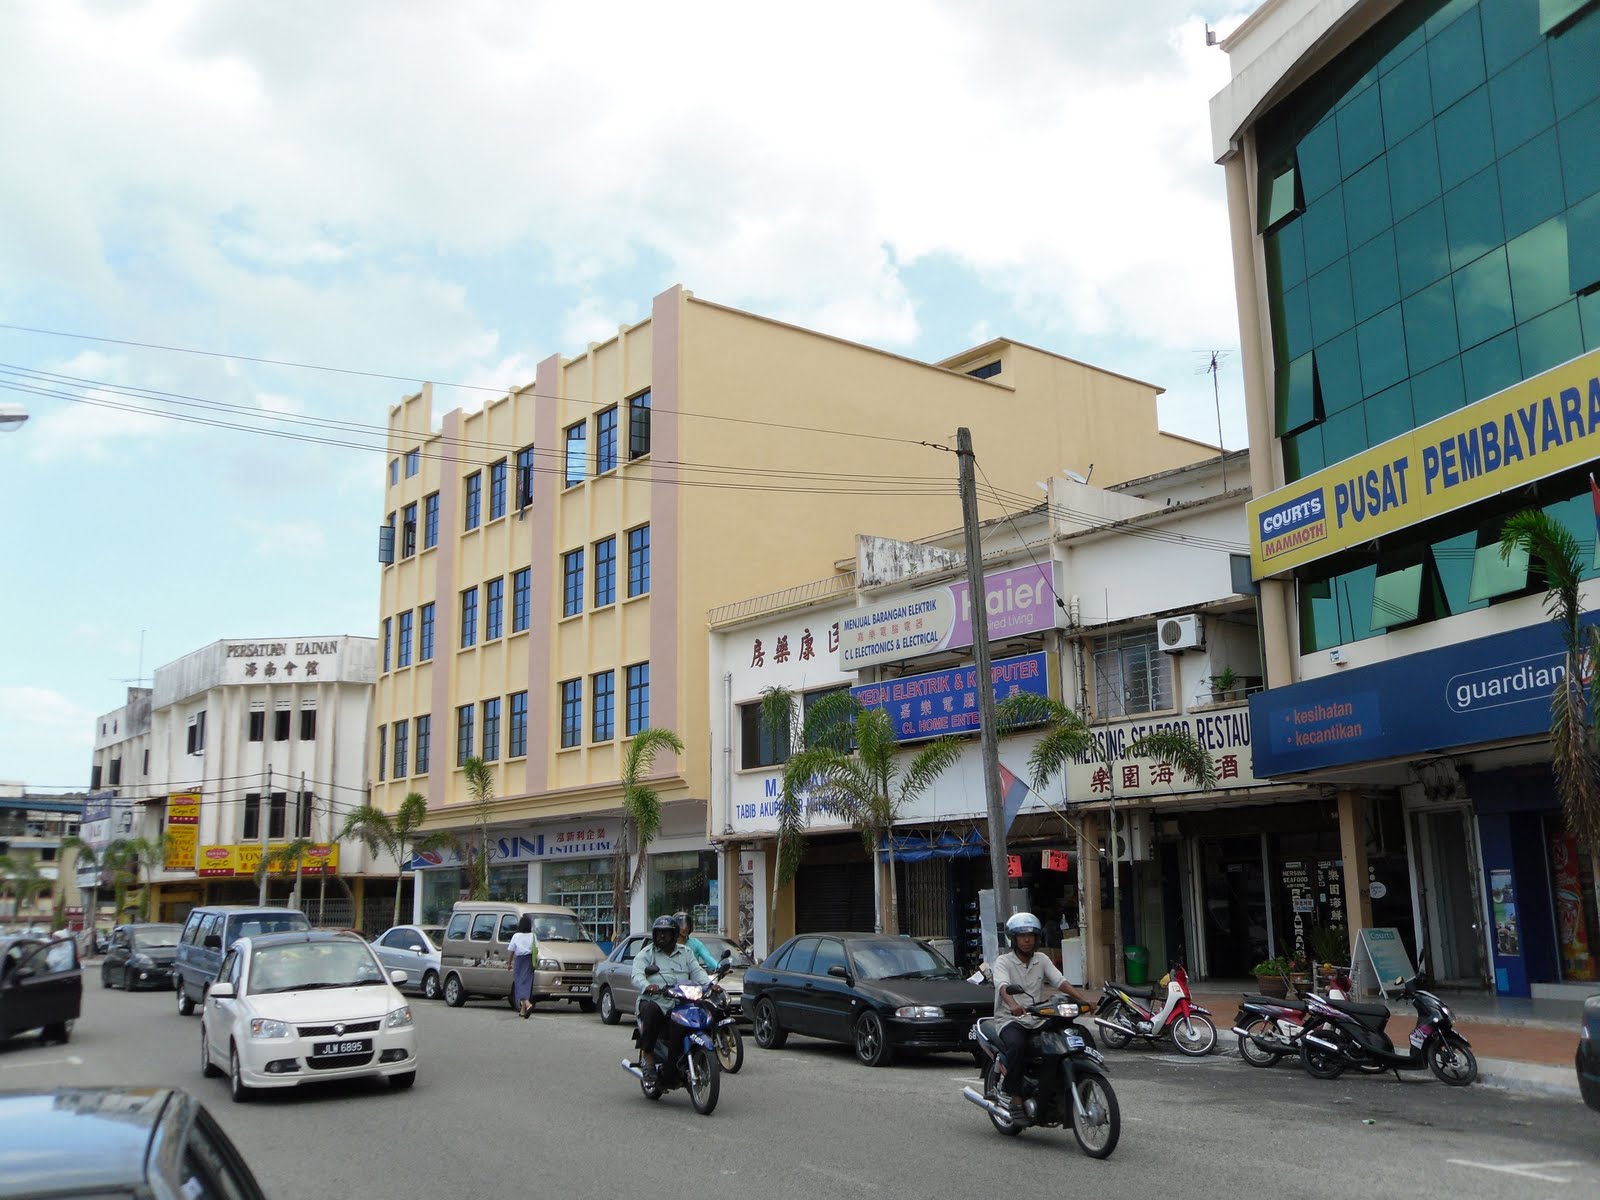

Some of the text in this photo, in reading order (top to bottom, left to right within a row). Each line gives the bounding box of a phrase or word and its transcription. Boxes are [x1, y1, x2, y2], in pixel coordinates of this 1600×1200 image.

[1334, 377, 1600, 529] PUSAT PEMBAYARA
[1263, 497, 1321, 532] COURTS
[1265, 523, 1324, 556] MAMMOTH
[844, 599, 937, 631] MENJUAL BARANGAN ELEKTRIK
[1008, 613, 1033, 626] Living
[226, 640, 338, 658] PERSATUAN HAINAN
[844, 631, 938, 661] C L ELECTRONICS & ELECTRICAL
[857, 659, 1040, 706] KEDAI ELEKTRIK & KMPUTER
[1456, 665, 1566, 708] guardian
[902, 721, 916, 735] CL
[918, 715, 949, 733] HOME
[1294, 702, 1353, 725] kesihatan
[1295, 723, 1363, 747] kecantikan
[765, 778, 780, 798] M.
[736, 803, 756, 819] TABIB
[549, 841, 613, 855] ENTERPRISE
[322, 1041, 363, 1054] JLW 6895
